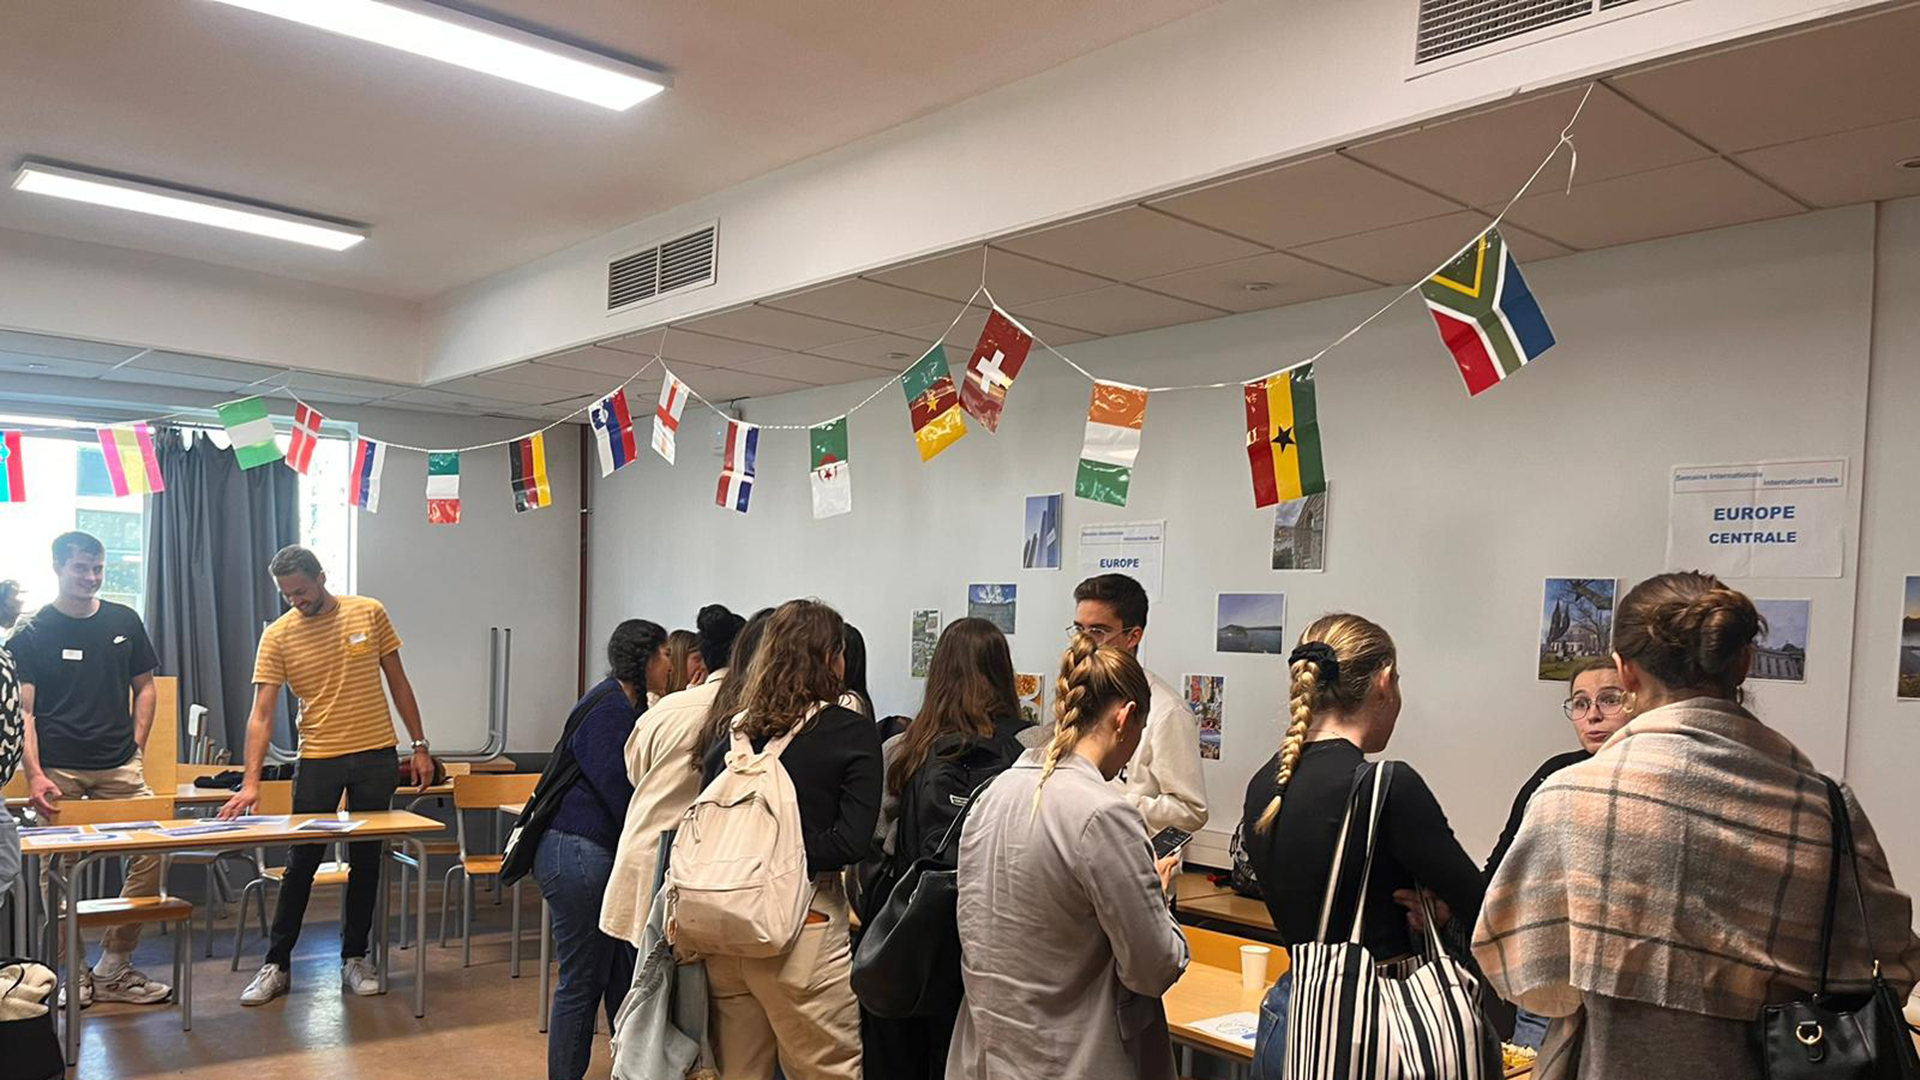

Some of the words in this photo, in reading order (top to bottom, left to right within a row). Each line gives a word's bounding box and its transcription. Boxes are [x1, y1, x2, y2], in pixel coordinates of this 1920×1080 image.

[1713, 505, 1796, 521] EUROPE
[1708, 531, 1797, 544] CENTRALE
[1099, 558, 1140, 568] EUROPE
